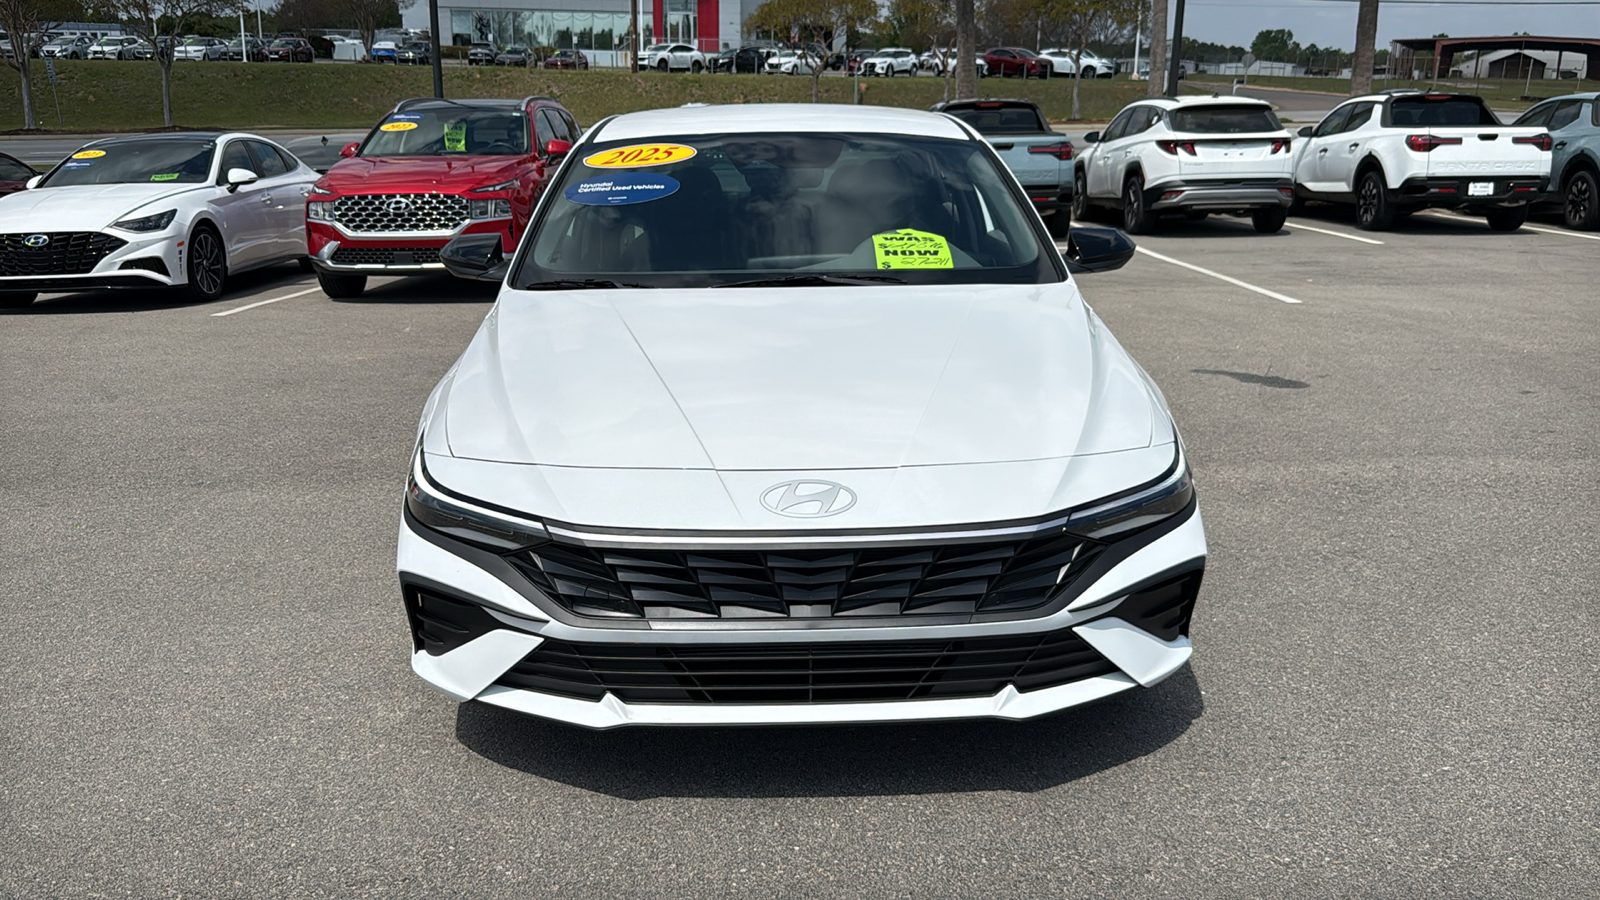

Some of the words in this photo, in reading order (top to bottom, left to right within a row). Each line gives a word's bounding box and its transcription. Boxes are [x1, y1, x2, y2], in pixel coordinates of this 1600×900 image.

[601, 146, 681, 165] 2025
[1435, 162, 1490, 171] SANTA
[1493, 162, 1535, 171] CRUZ
[580, 181, 614, 189] Hyundai
[881, 261, 892, 270] $
